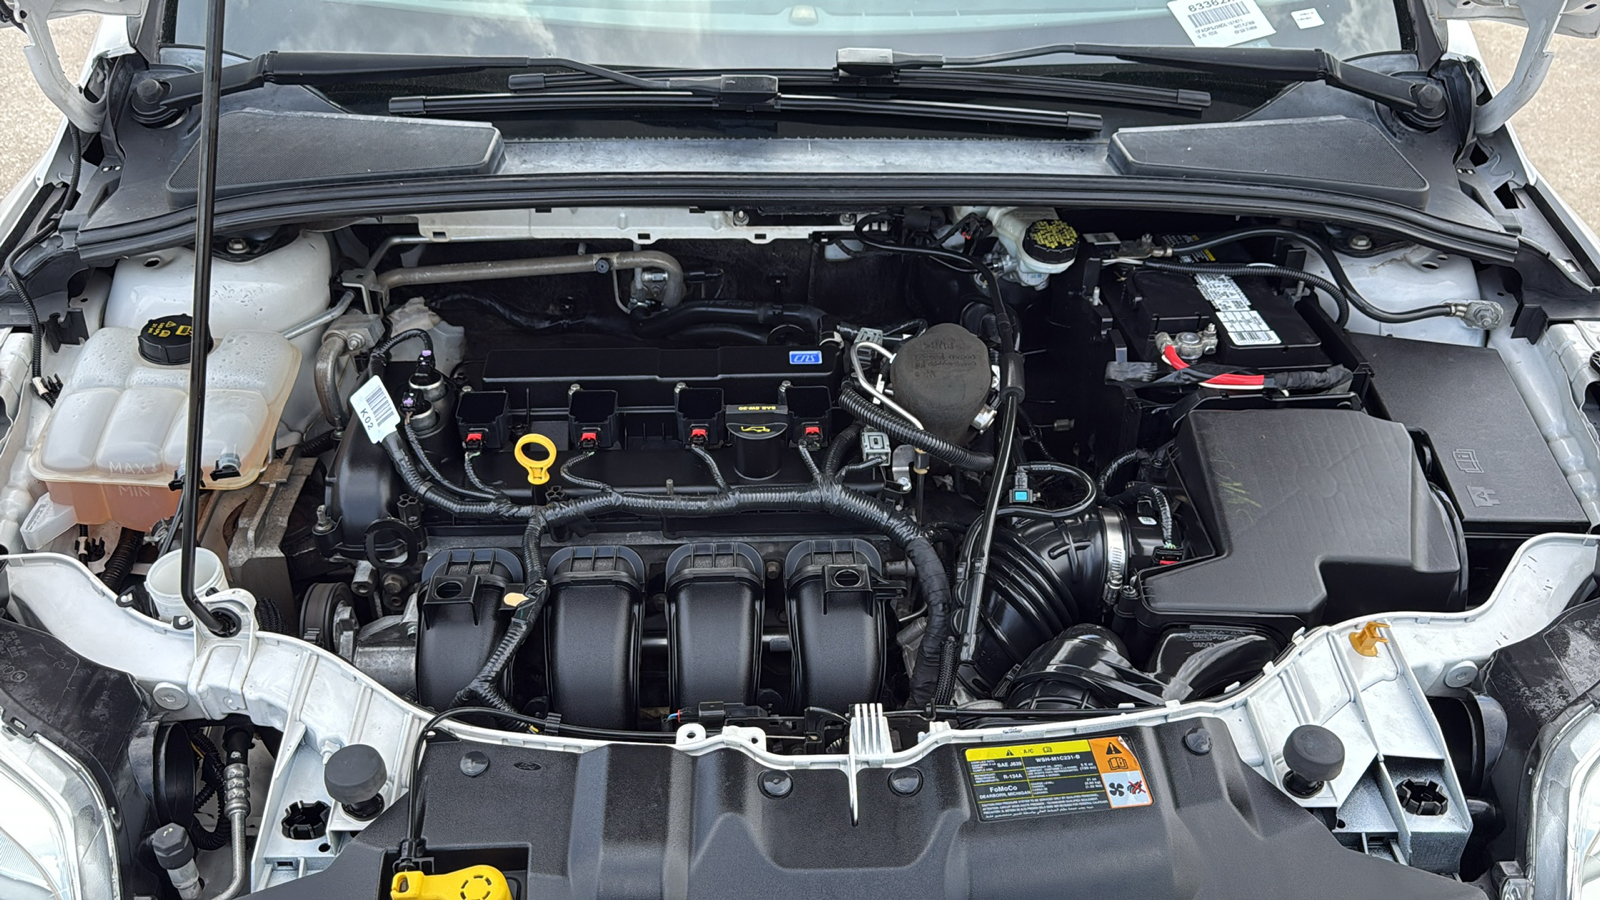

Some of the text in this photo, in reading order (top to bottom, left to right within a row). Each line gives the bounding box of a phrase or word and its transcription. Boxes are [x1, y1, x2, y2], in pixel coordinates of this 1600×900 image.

[360, 408, 374, 430] K02
[108, 461, 146, 475] MAX
[118, 485, 151, 497] MIN
[989, 785, 1018, 793] FoMoCo
